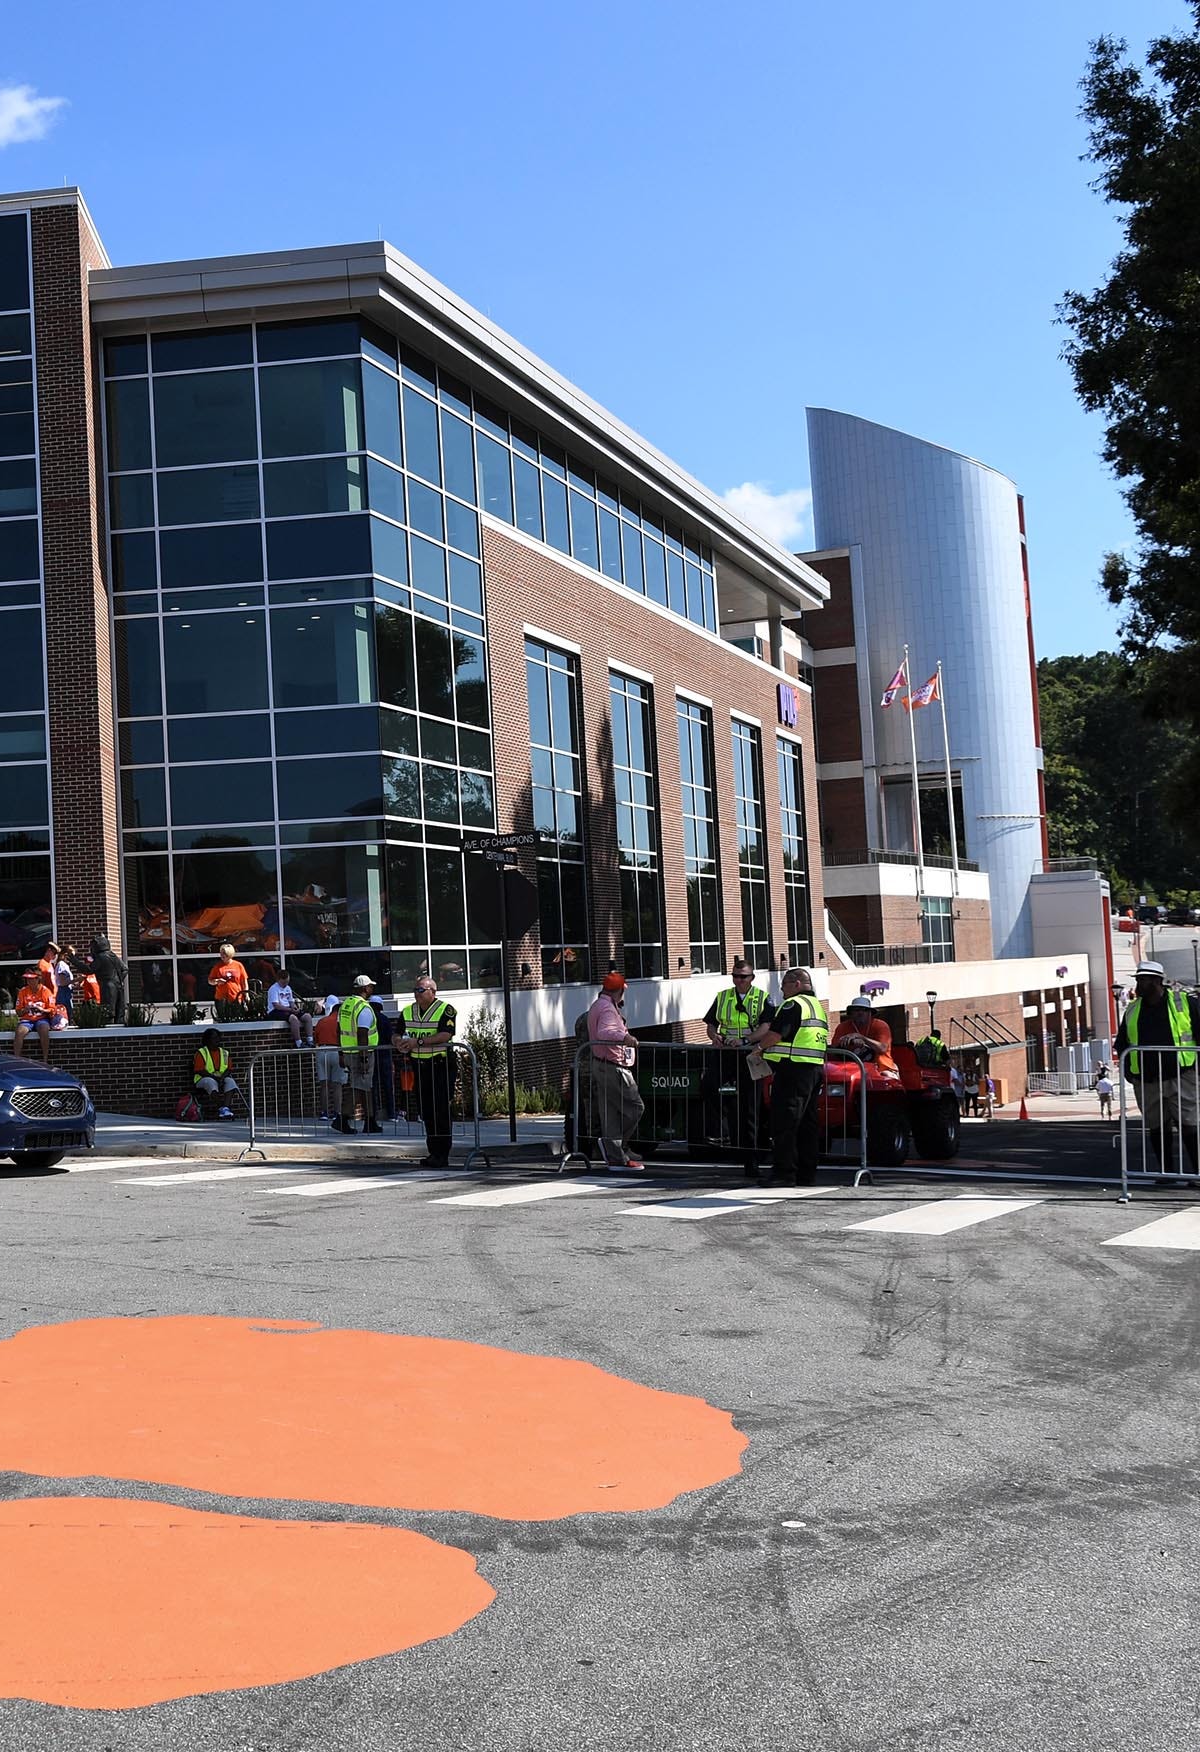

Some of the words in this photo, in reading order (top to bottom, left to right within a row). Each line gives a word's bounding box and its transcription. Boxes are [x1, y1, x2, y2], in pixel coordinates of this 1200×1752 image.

[464, 840, 480, 850] AVE.
[480, 838, 490, 849] OF
[491, 834, 534, 847] CHAMPIONS
[651, 1076, 690, 1088] SQUAD
